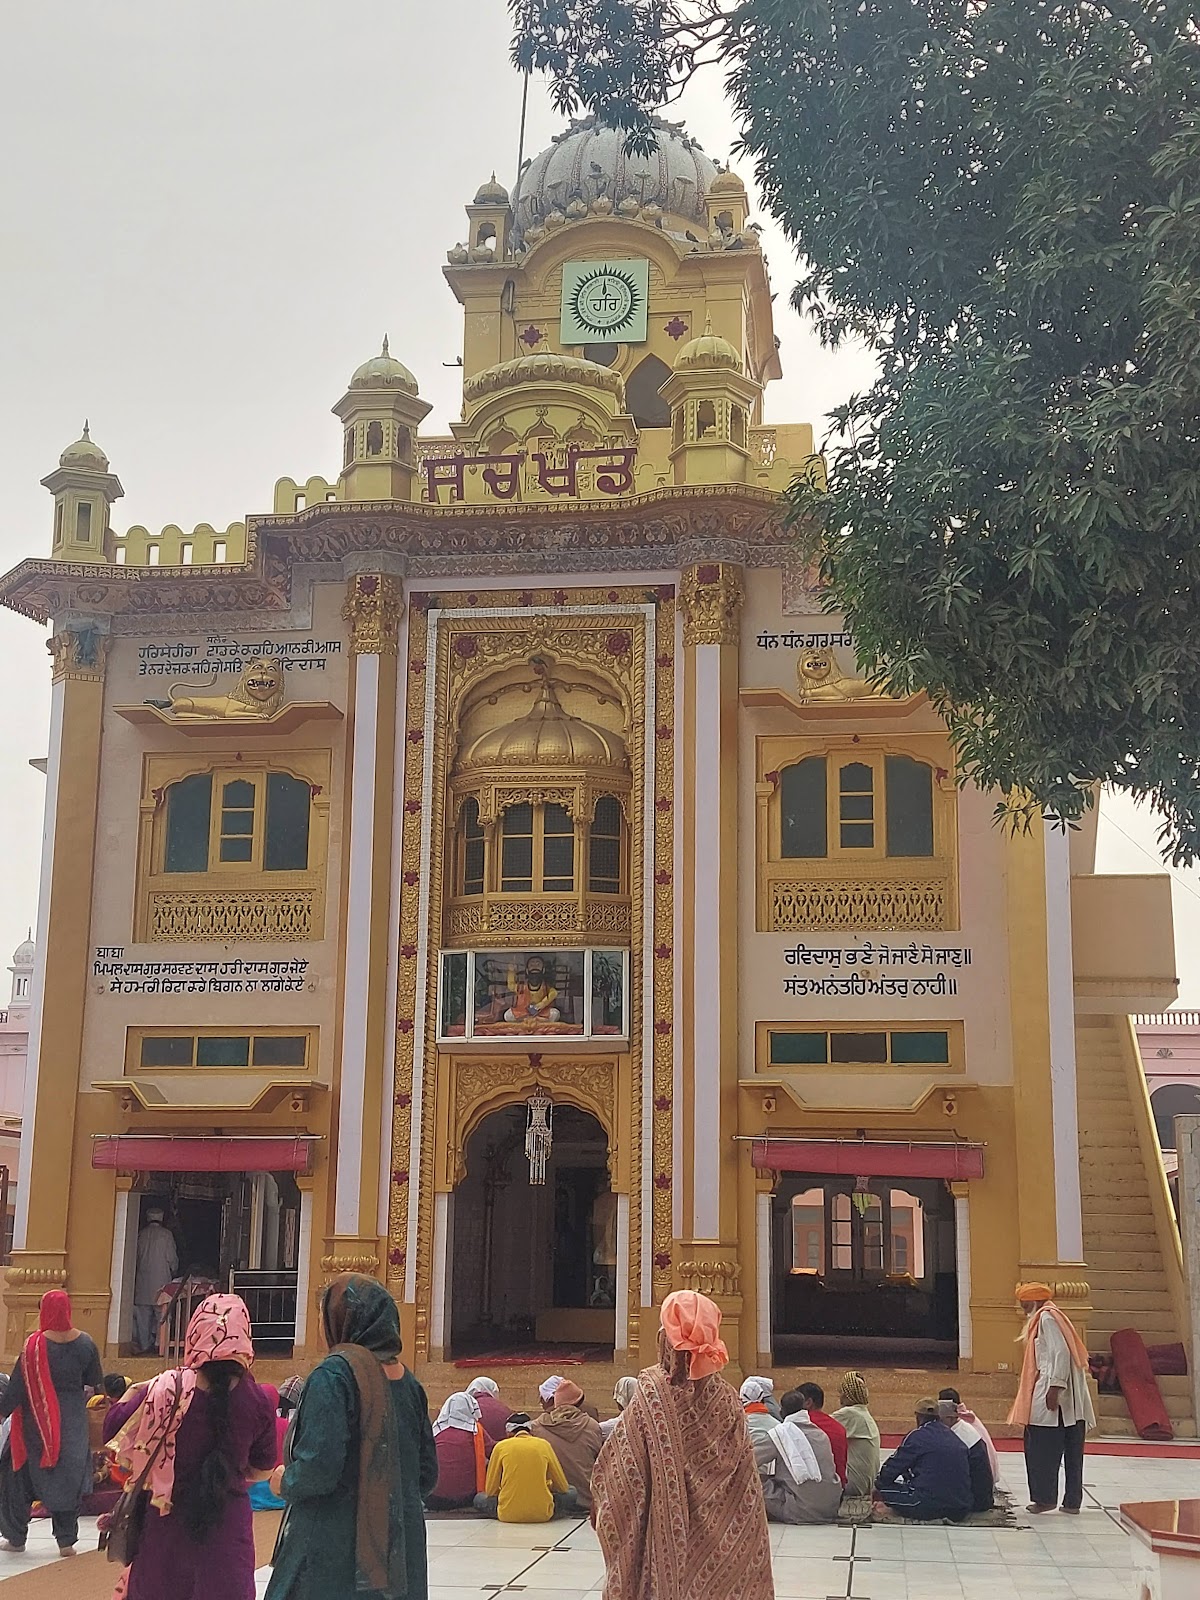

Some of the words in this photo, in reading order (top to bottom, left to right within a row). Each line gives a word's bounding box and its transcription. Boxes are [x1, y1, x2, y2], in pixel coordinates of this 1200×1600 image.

[589, 294, 620, 311] ਹਰਿ
[756, 630, 779, 650] ਧੰਨ
[781, 630, 805, 649] ਧੰਨ
[96, 947, 124, 959] ਬਾਬਾ
[784, 943, 842, 968] ਰਵਿਦਾਸੁ
[783, 974, 808, 995] ਸੰਤ
